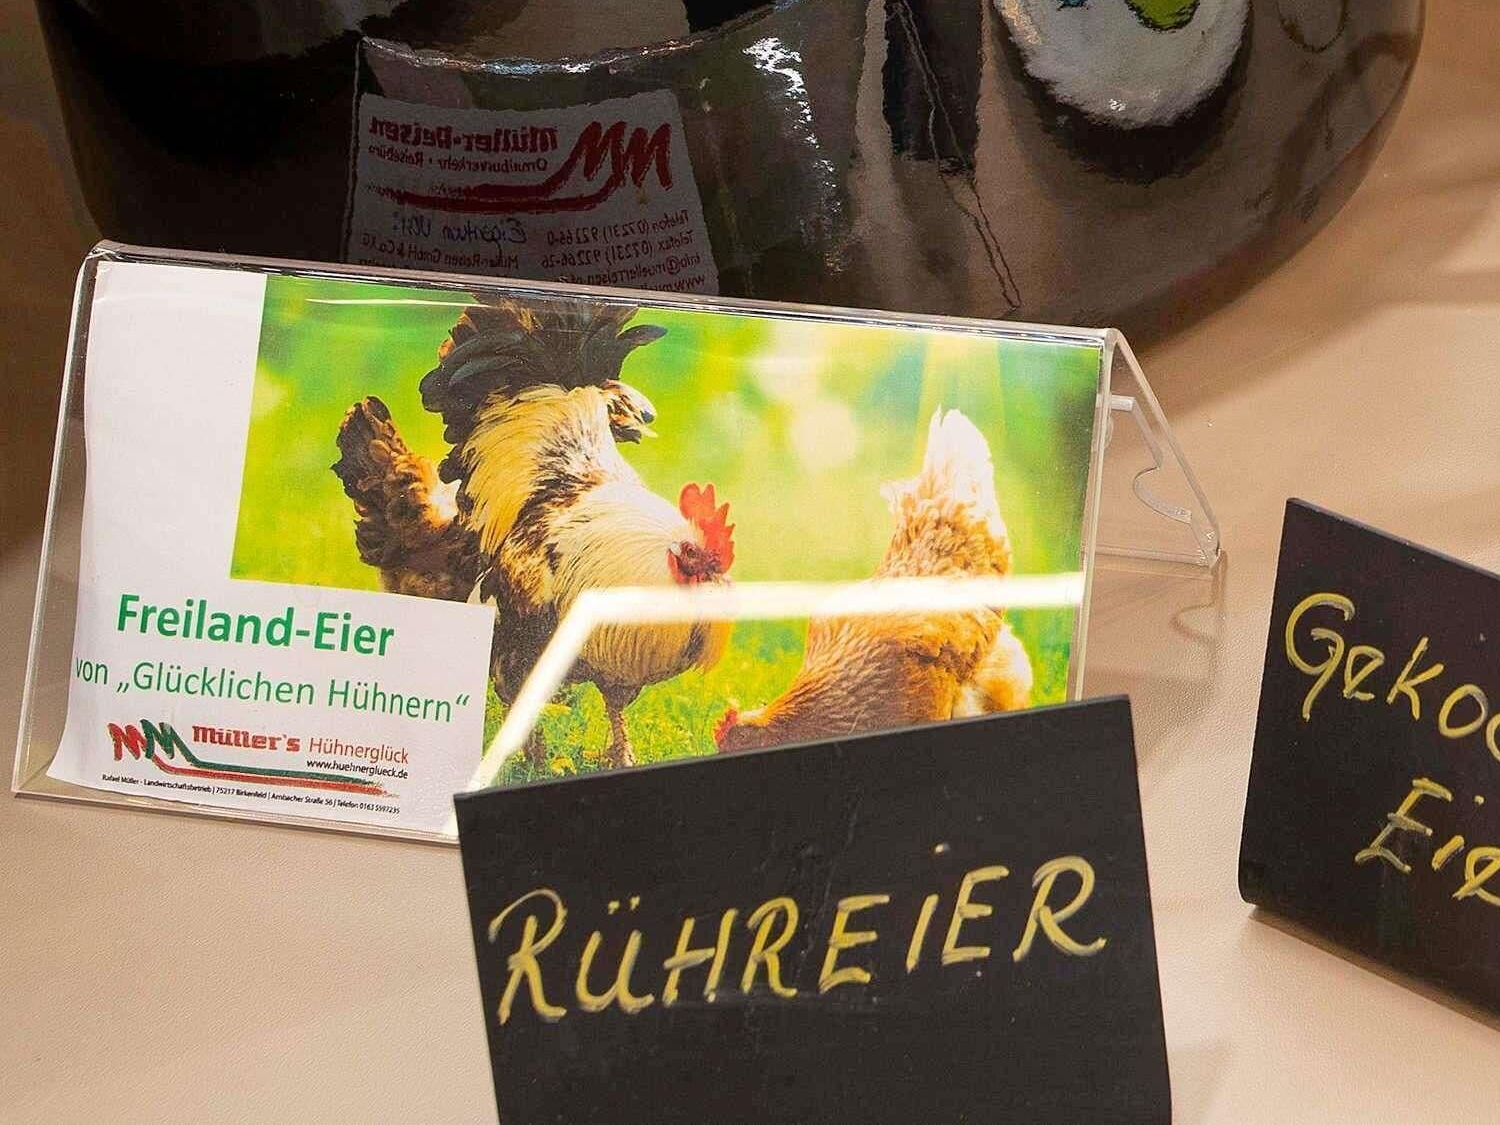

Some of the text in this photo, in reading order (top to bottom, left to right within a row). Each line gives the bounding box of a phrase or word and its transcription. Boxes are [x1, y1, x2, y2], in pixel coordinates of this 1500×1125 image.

[117, 593, 395, 656] Freiland-Eier
[76, 657, 109, 686] von
[308, 736, 409, 765] Hühnerglück
[102, 774, 120, 783] Rafael
[121, 776, 139, 785] Müller
[143, 778, 212, 793] Landwirtschaftsbetrieb
[306, 758, 409, 780] www.huehnerglueck.de
[488, 843, 1107, 1024] RÜHREIER
